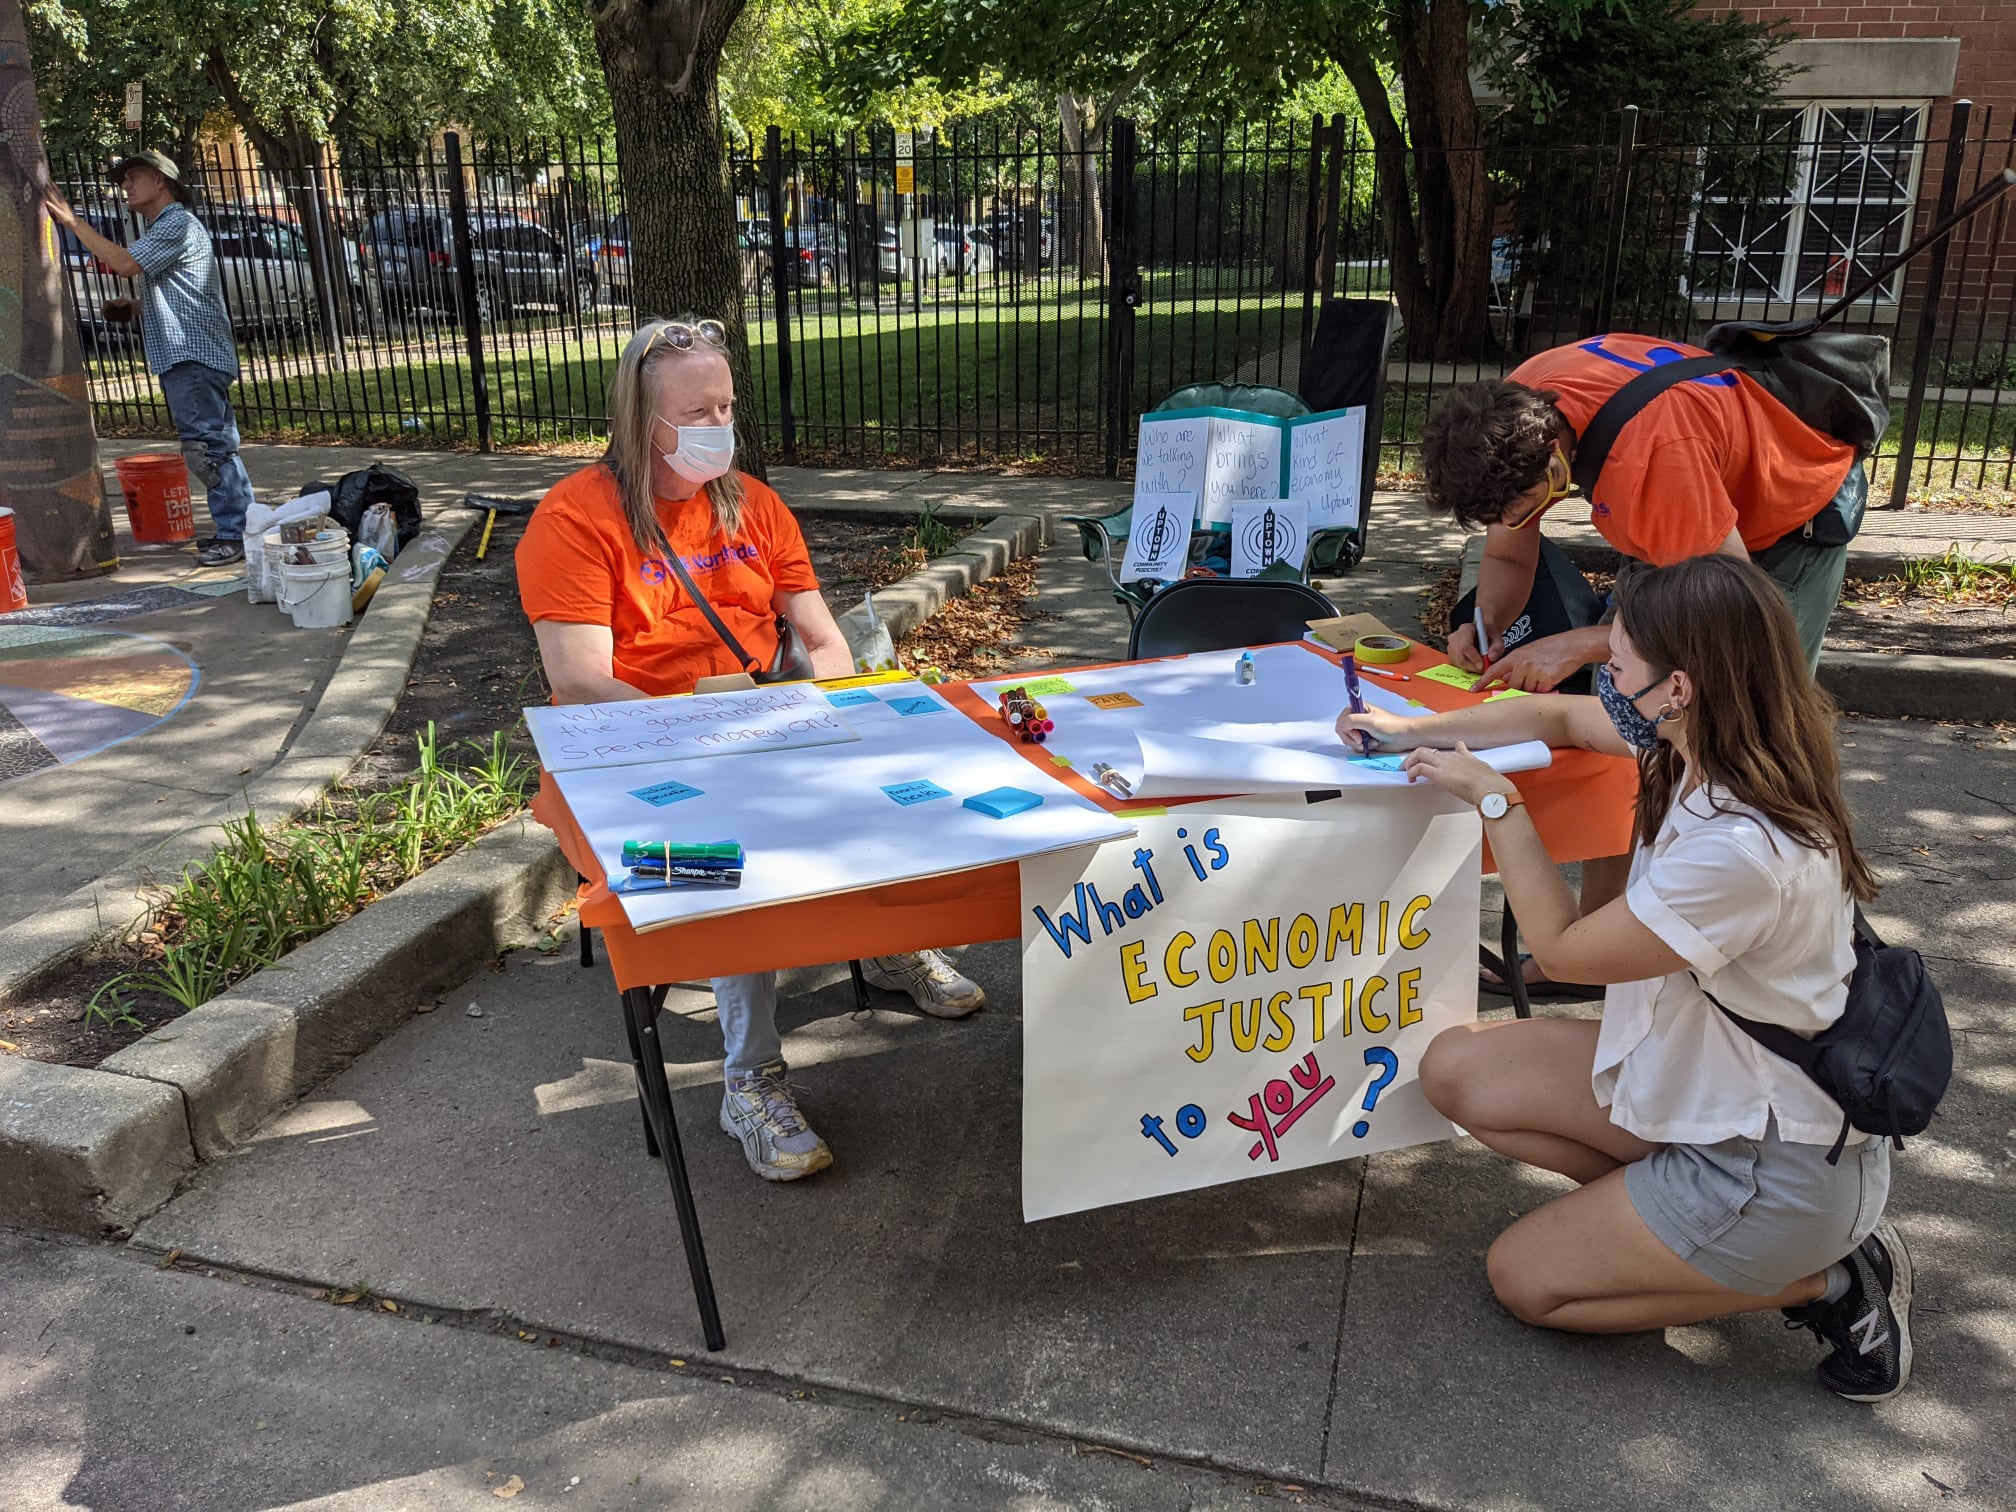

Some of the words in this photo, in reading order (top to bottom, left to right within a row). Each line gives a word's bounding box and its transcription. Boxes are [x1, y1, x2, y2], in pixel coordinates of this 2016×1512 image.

[898, 145, 911, 154] 20
[1144, 429, 1169, 445] Who
[1175, 430, 1195, 442] are
[1216, 424, 1255, 446] What
[1293, 426, 1328, 448] What
[1158, 447, 1193, 470] talking
[1215, 448, 1269, 480] brings
[1327, 442, 1344, 465] of
[1291, 468, 1342, 492] economy
[1211, 481, 1235, 504] you
[165, 498, 191, 519] DO
[168, 518, 192, 531] THIS
[1149, 511, 1166, 560] UPTOWN
[1264, 513, 1274, 566] UPTOWN
[1091, 695, 1124, 705] FAIR
[560, 704, 660, 722] What
[560, 725, 619, 738] the
[646, 702, 802, 732] government
[694, 727, 787, 746] money
[672, 866, 706, 877] Sharpie
[1033, 847, 1165, 958] What
[1177, 827, 1229, 882] is
[1120, 894, 1432, 1004] ECONOMIC
[1183, 967, 1423, 1063] JUSTICE
[1140, 1103, 1207, 1157] to
[1227, 1052, 1322, 1162] you
